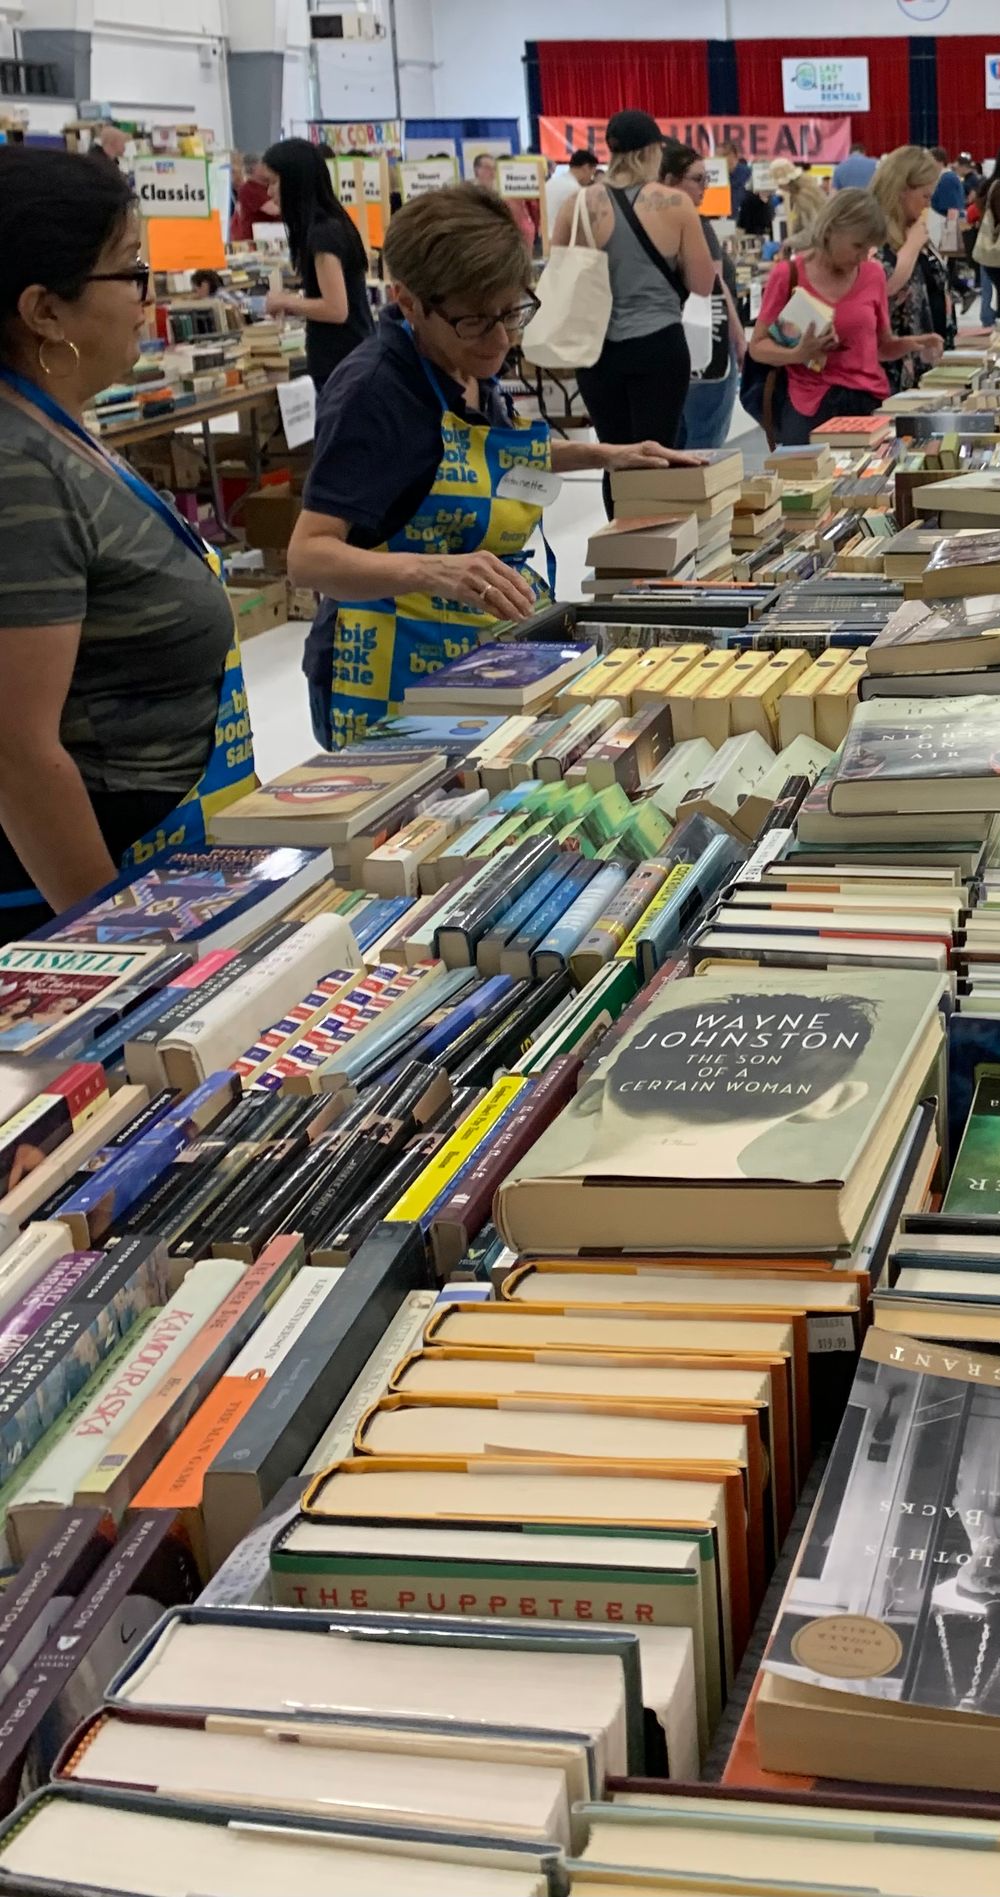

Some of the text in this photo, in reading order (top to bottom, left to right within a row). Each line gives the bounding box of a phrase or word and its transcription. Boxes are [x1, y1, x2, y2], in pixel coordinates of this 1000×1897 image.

[820, 65, 843, 73] LAZY
[820, 75, 839, 83] DAY
[821, 84, 844, 92] RAFT
[821, 93, 862, 101] RENTALS
[349, 120, 400, 144] CORRAL
[670, 122, 823, 157] UNREAD
[141, 185, 205, 200] Classics
[442, 429, 470, 450] big
[436, 467, 478, 484] sale
[341, 623, 377, 650] big
[910, 751, 961, 760] AIR
[918, 742, 955, 750] ON
[694, 1013, 831, 1031] WAYNE
[635, 1032, 860, 1050] JOHNSTON
[685, 1054, 783, 1065] THE SON
[697, 1067, 749, 1079] OF A
[618, 1080, 812, 1096] CERTAIN WOMAN
[36, 1257, 96, 1309] MICHAEL
[258, 1277, 329, 1360] LEE HENDERSON
[51, 1319, 80, 1347] THE
[76, 1309, 195, 1438] KAMOURASKA
[214, 1398, 244, 1426] THE
[195, 1424, 226, 1454] MAN
[879, 1499, 984, 1527] BACKS
[48, 1517, 84, 1559] WAYNE
[73, 1520, 155, 1630] WAYNE JOHNSTON
[0, 1561, 52, 1634] JOHNSTON
[293, 1586, 655, 1623] THE PUPPETEER
[0, 1673, 48, 1738] A WORLD
